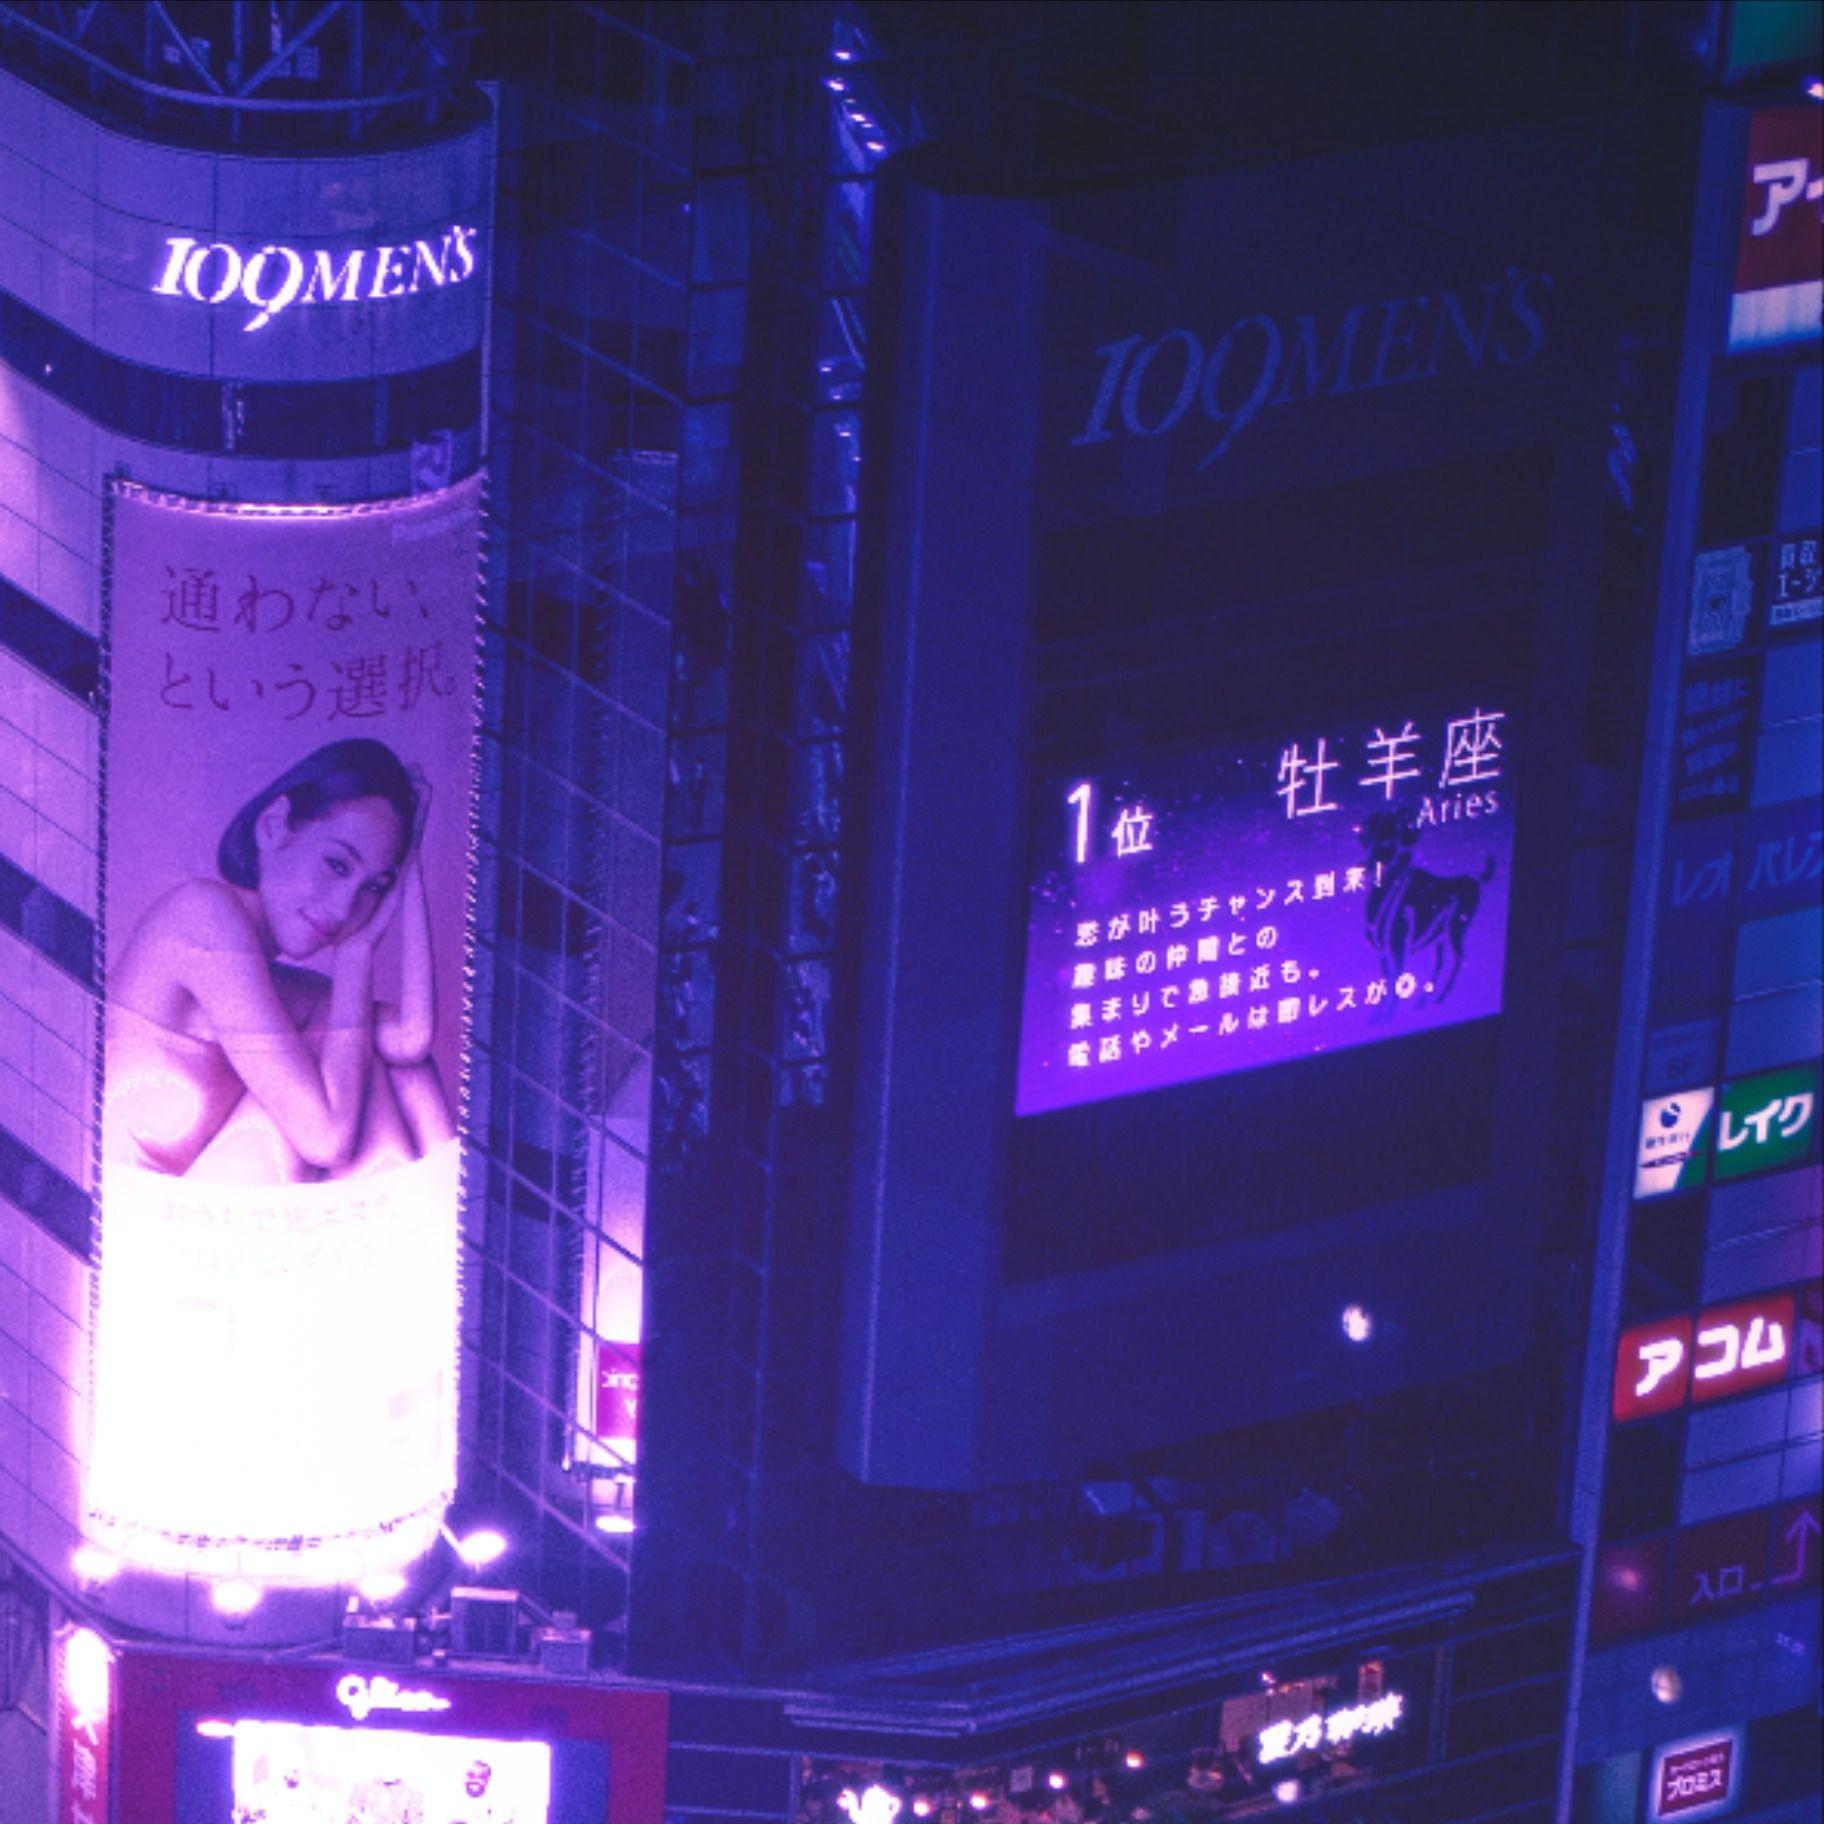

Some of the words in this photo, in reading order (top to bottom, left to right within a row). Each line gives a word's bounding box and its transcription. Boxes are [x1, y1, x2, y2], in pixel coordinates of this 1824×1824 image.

[160, 563, 430, 636] 通わない、
[158, 640, 457, 722] という選択。
[1275, 706, 1506, 820] 牡羊座
[1414, 789, 1501, 830] Aries
[1719, 1092, 1815, 1152] レイク
[1635, 1315, 1787, 1397] アコム
[1689, 1563, 1745, 1607] 入口
[1666, 1769, 1725, 1802] プロミス
